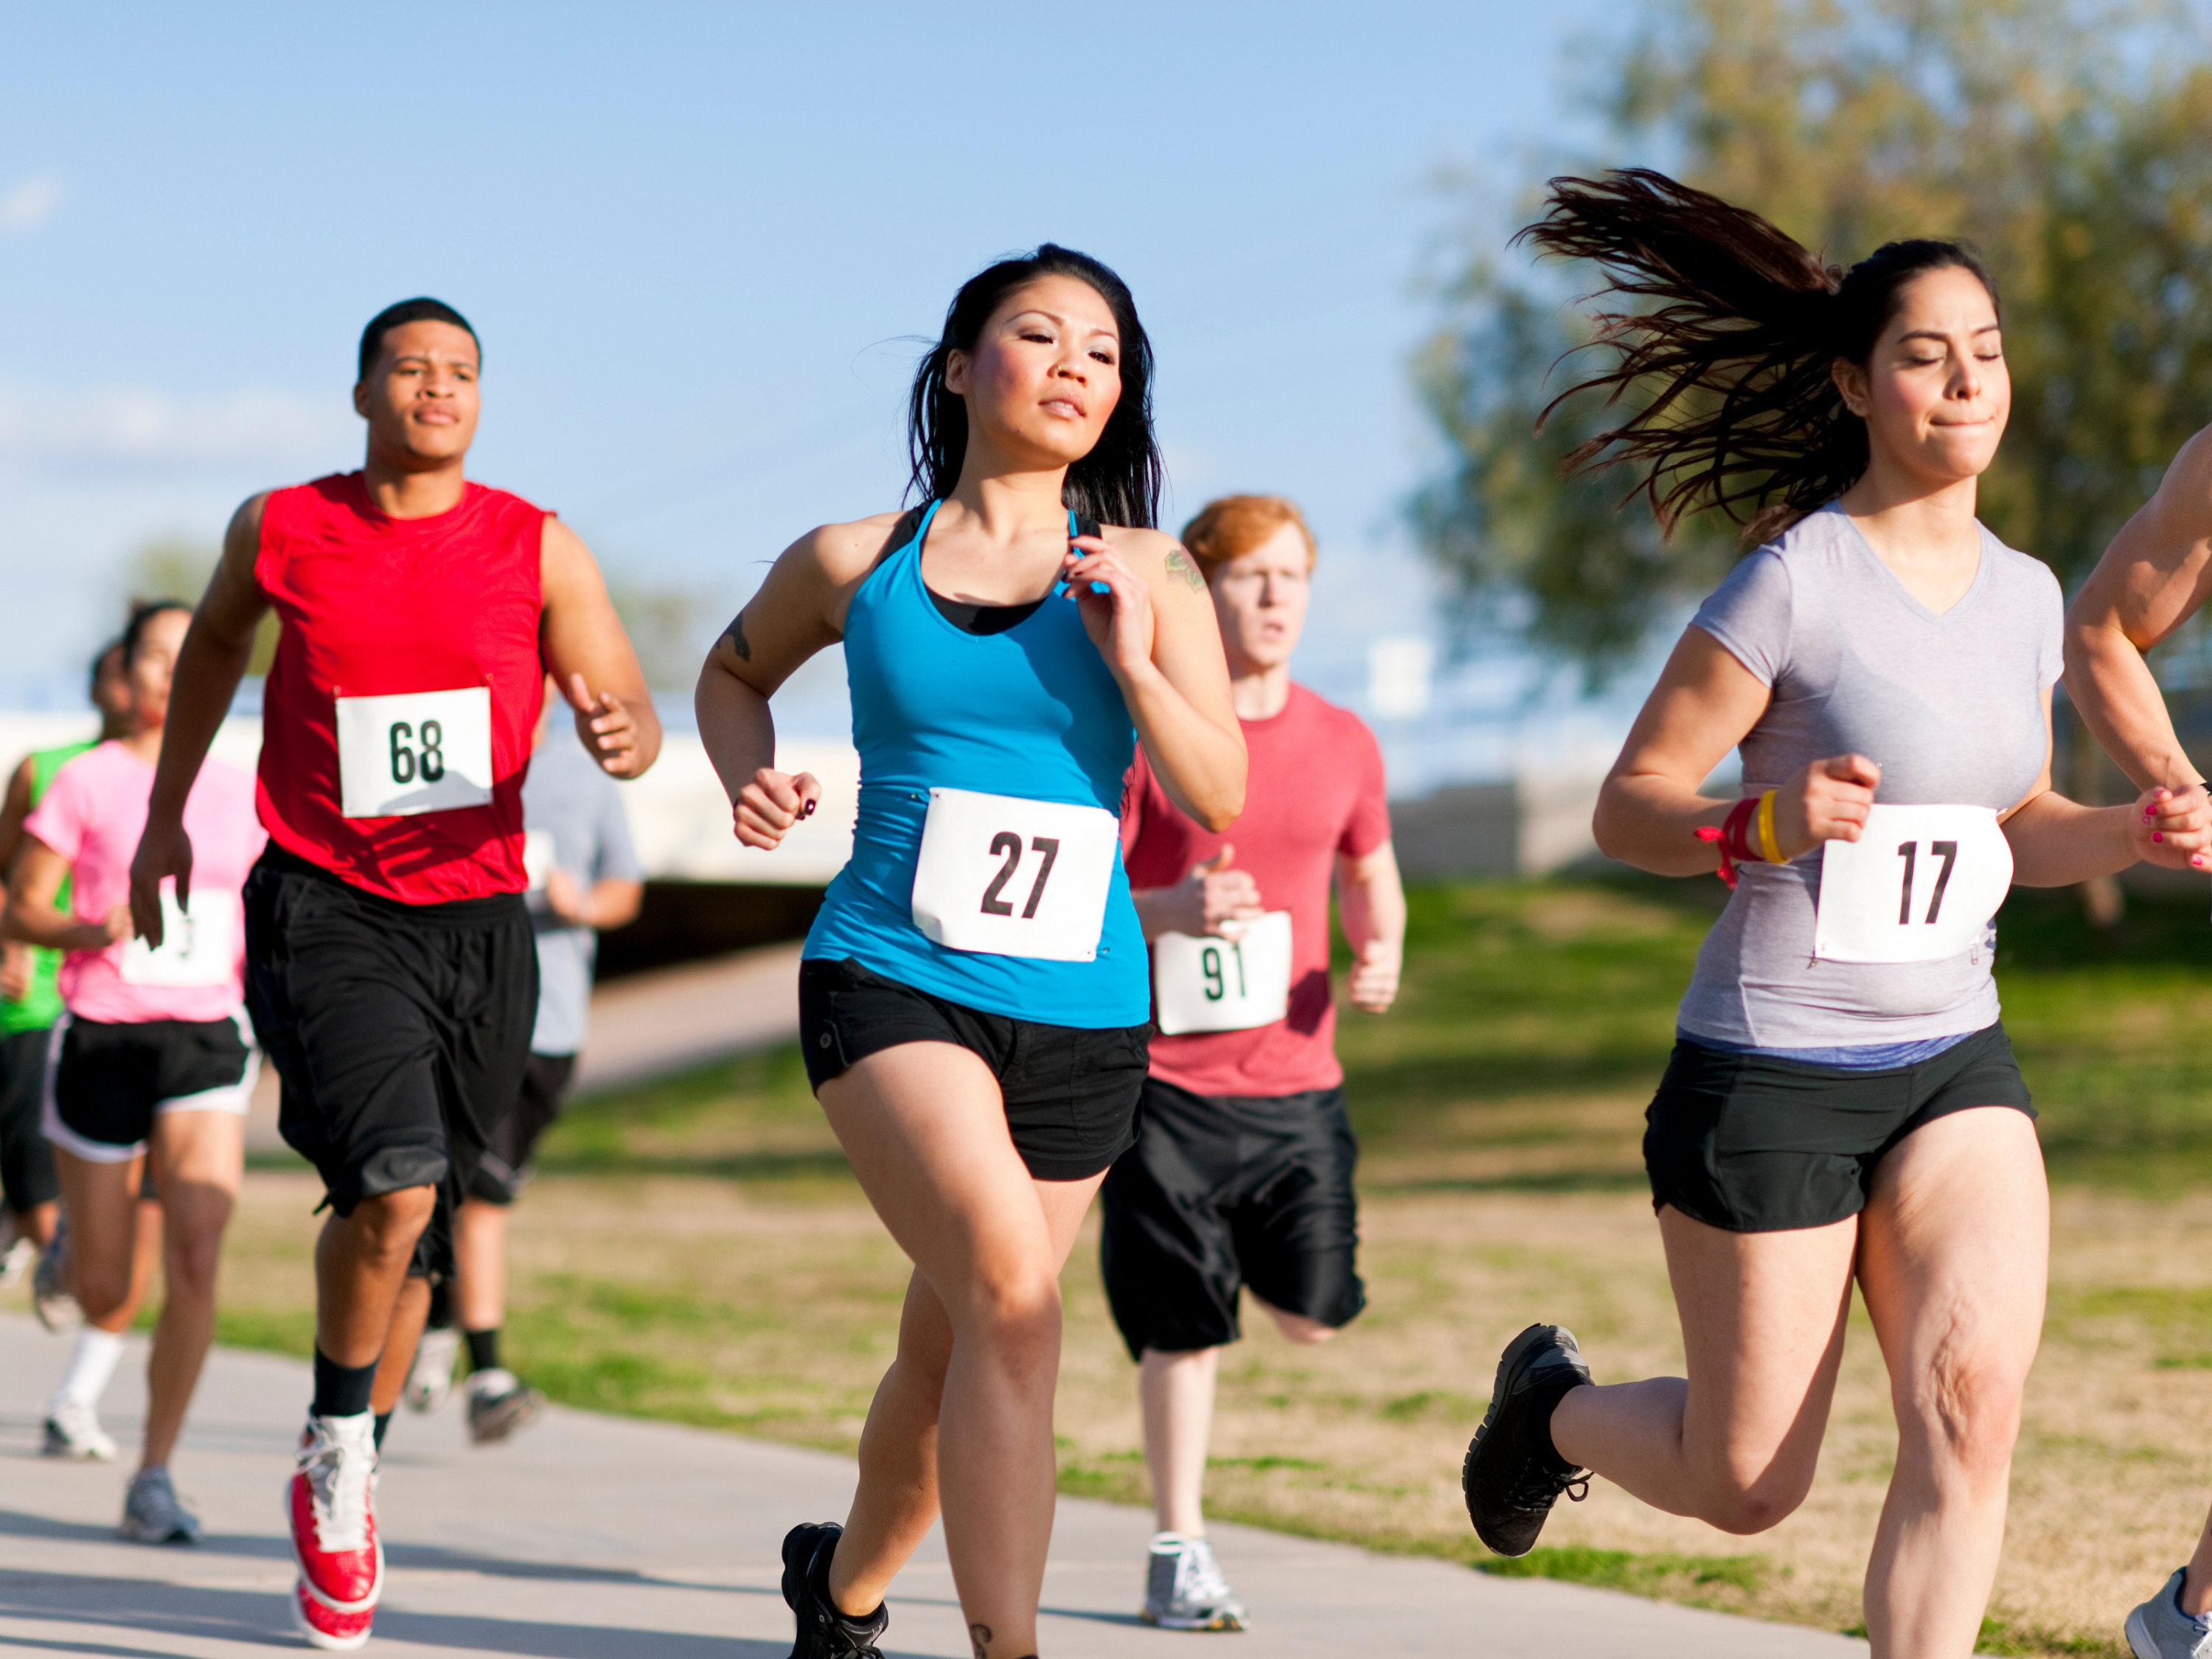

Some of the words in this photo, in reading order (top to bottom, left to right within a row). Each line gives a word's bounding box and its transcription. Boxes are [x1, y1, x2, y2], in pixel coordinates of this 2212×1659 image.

[389, 720, 444, 784] 68
[980, 831, 1060, 919] 27
[1898, 841, 1958, 925] 17
[1202, 941, 1246, 1001] 91
